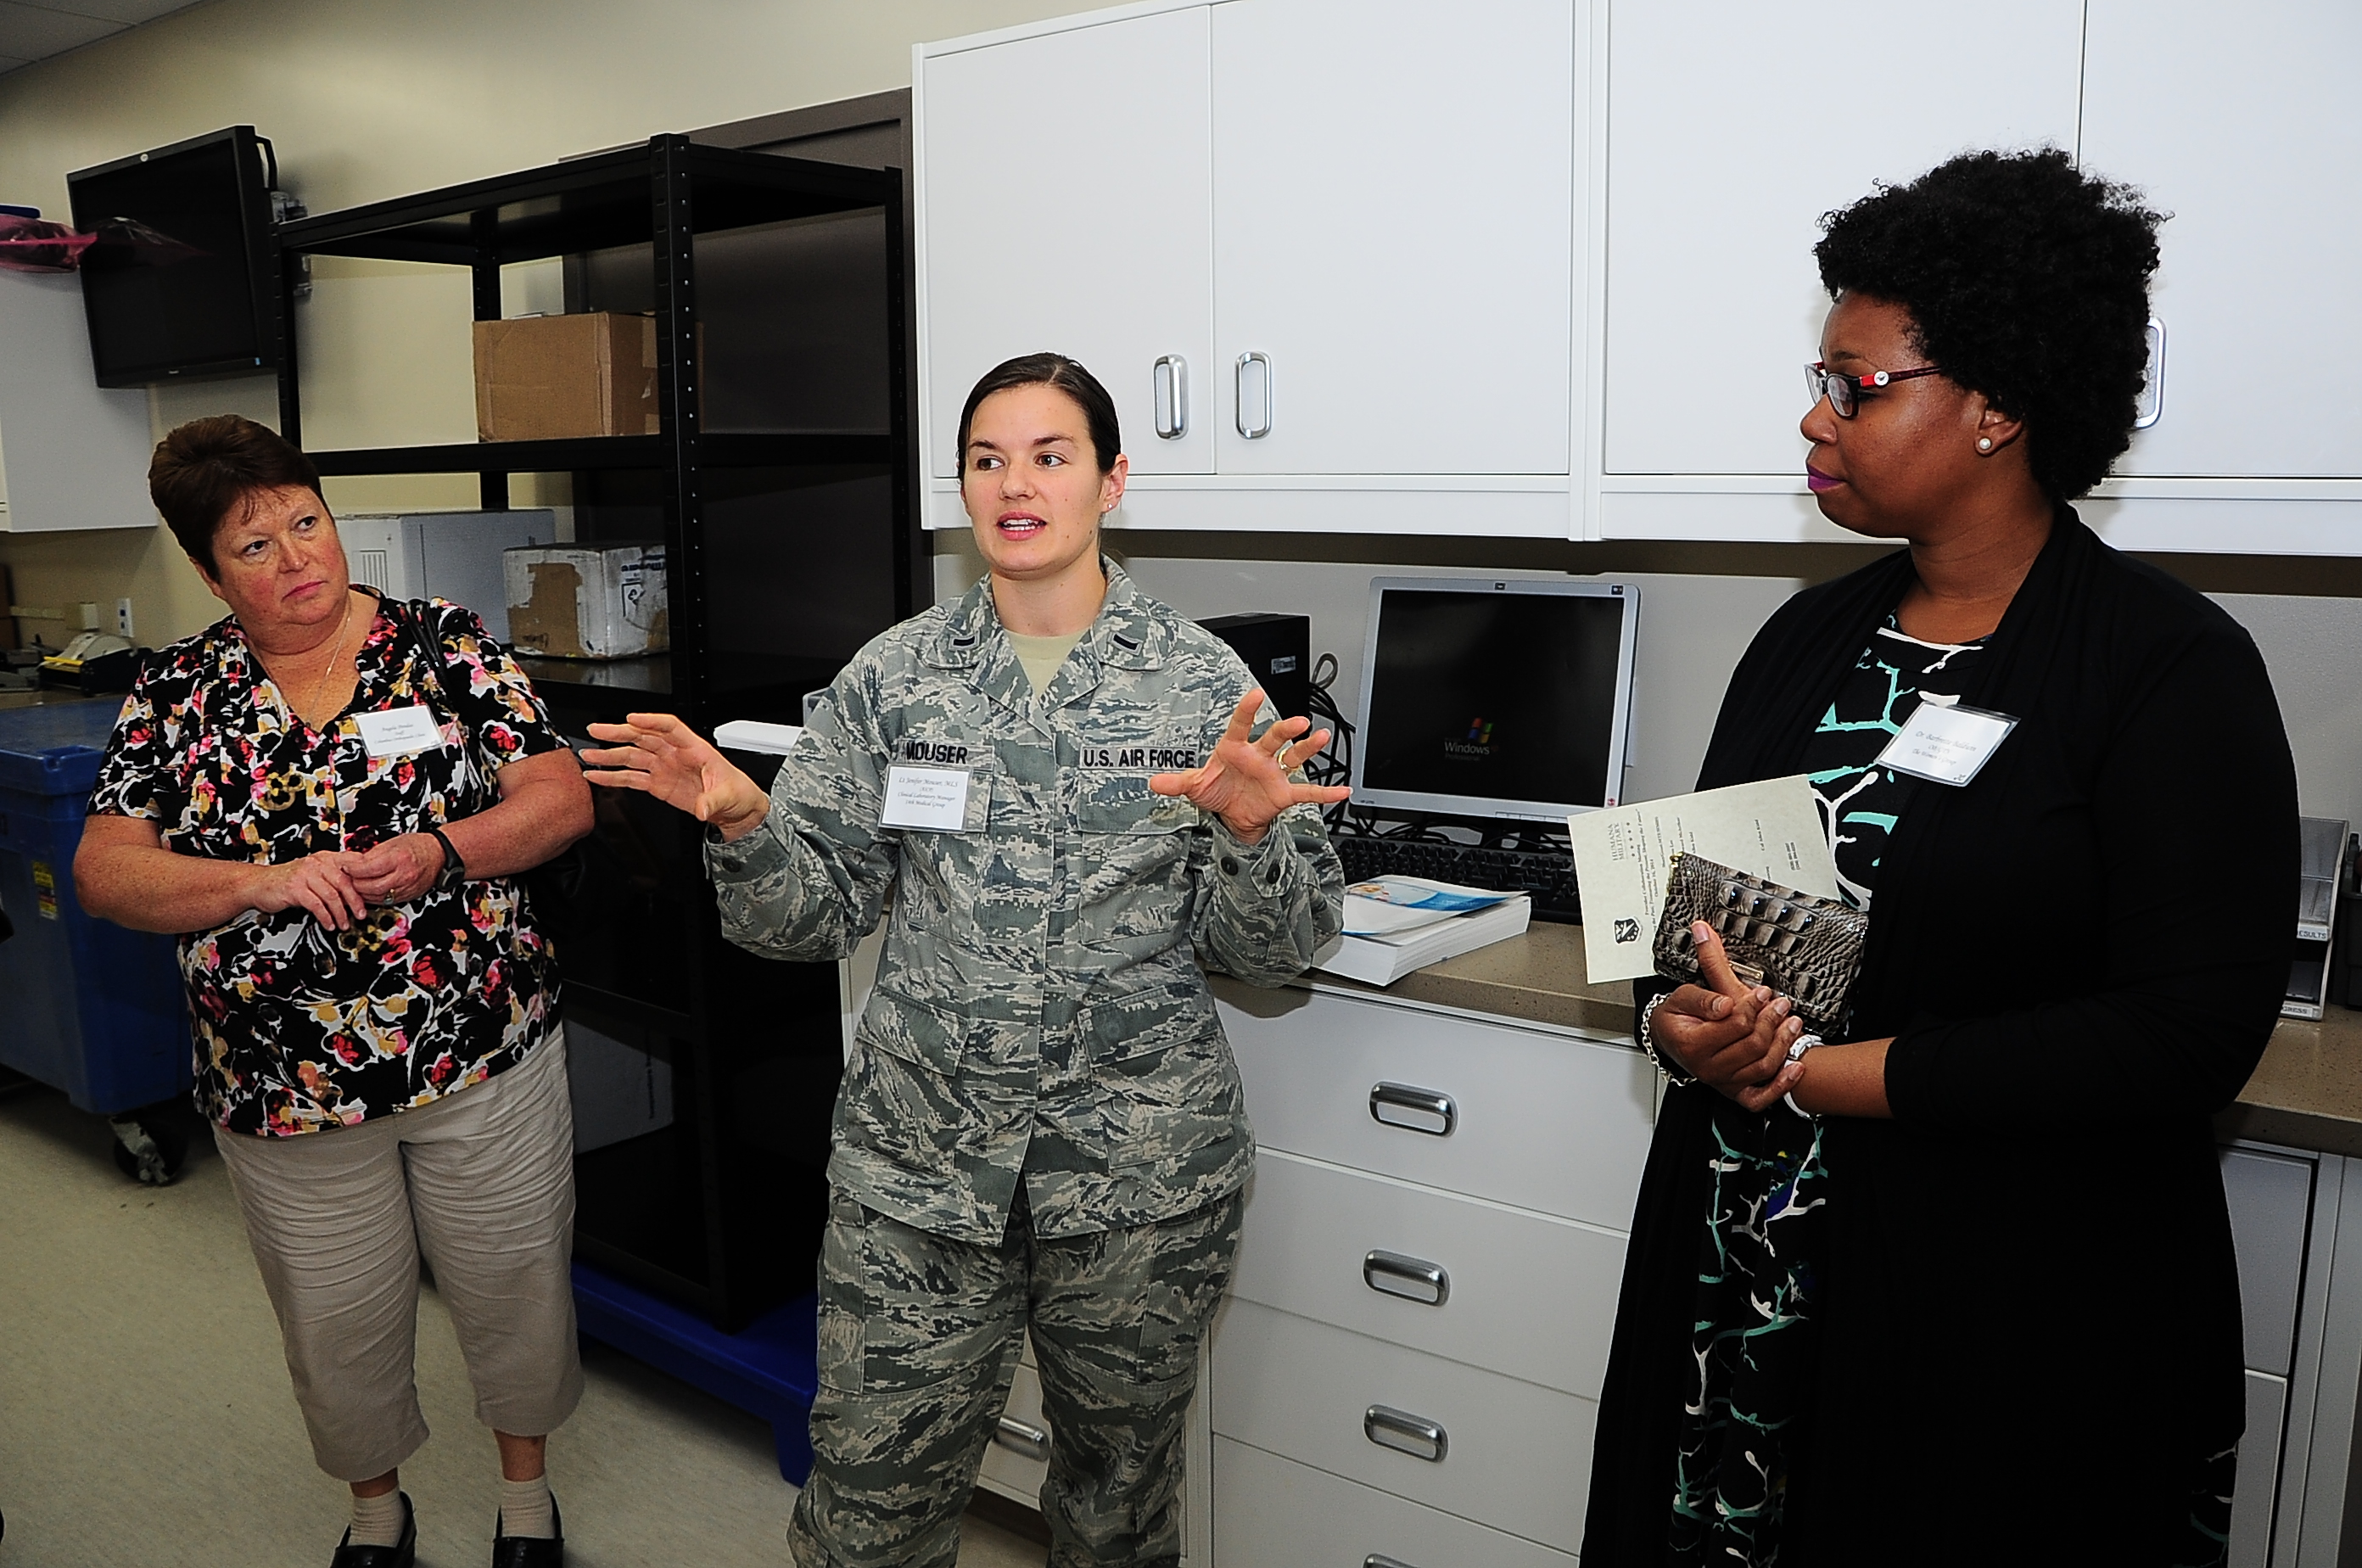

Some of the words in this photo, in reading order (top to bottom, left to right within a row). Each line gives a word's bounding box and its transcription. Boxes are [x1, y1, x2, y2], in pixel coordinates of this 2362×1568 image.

[906, 742, 968, 764] MOUSER
[1083, 749, 1113, 767] U.S.
[1118, 749, 1145, 767] AIR
[1149, 749, 1196, 769] FORCE
[1444, 742, 1491, 755] Windows
[1607, 823, 1618, 860] HUMANA
[1613, 822, 1624, 860] MILITARY
[2299, 930, 2326, 938] ESULTS
